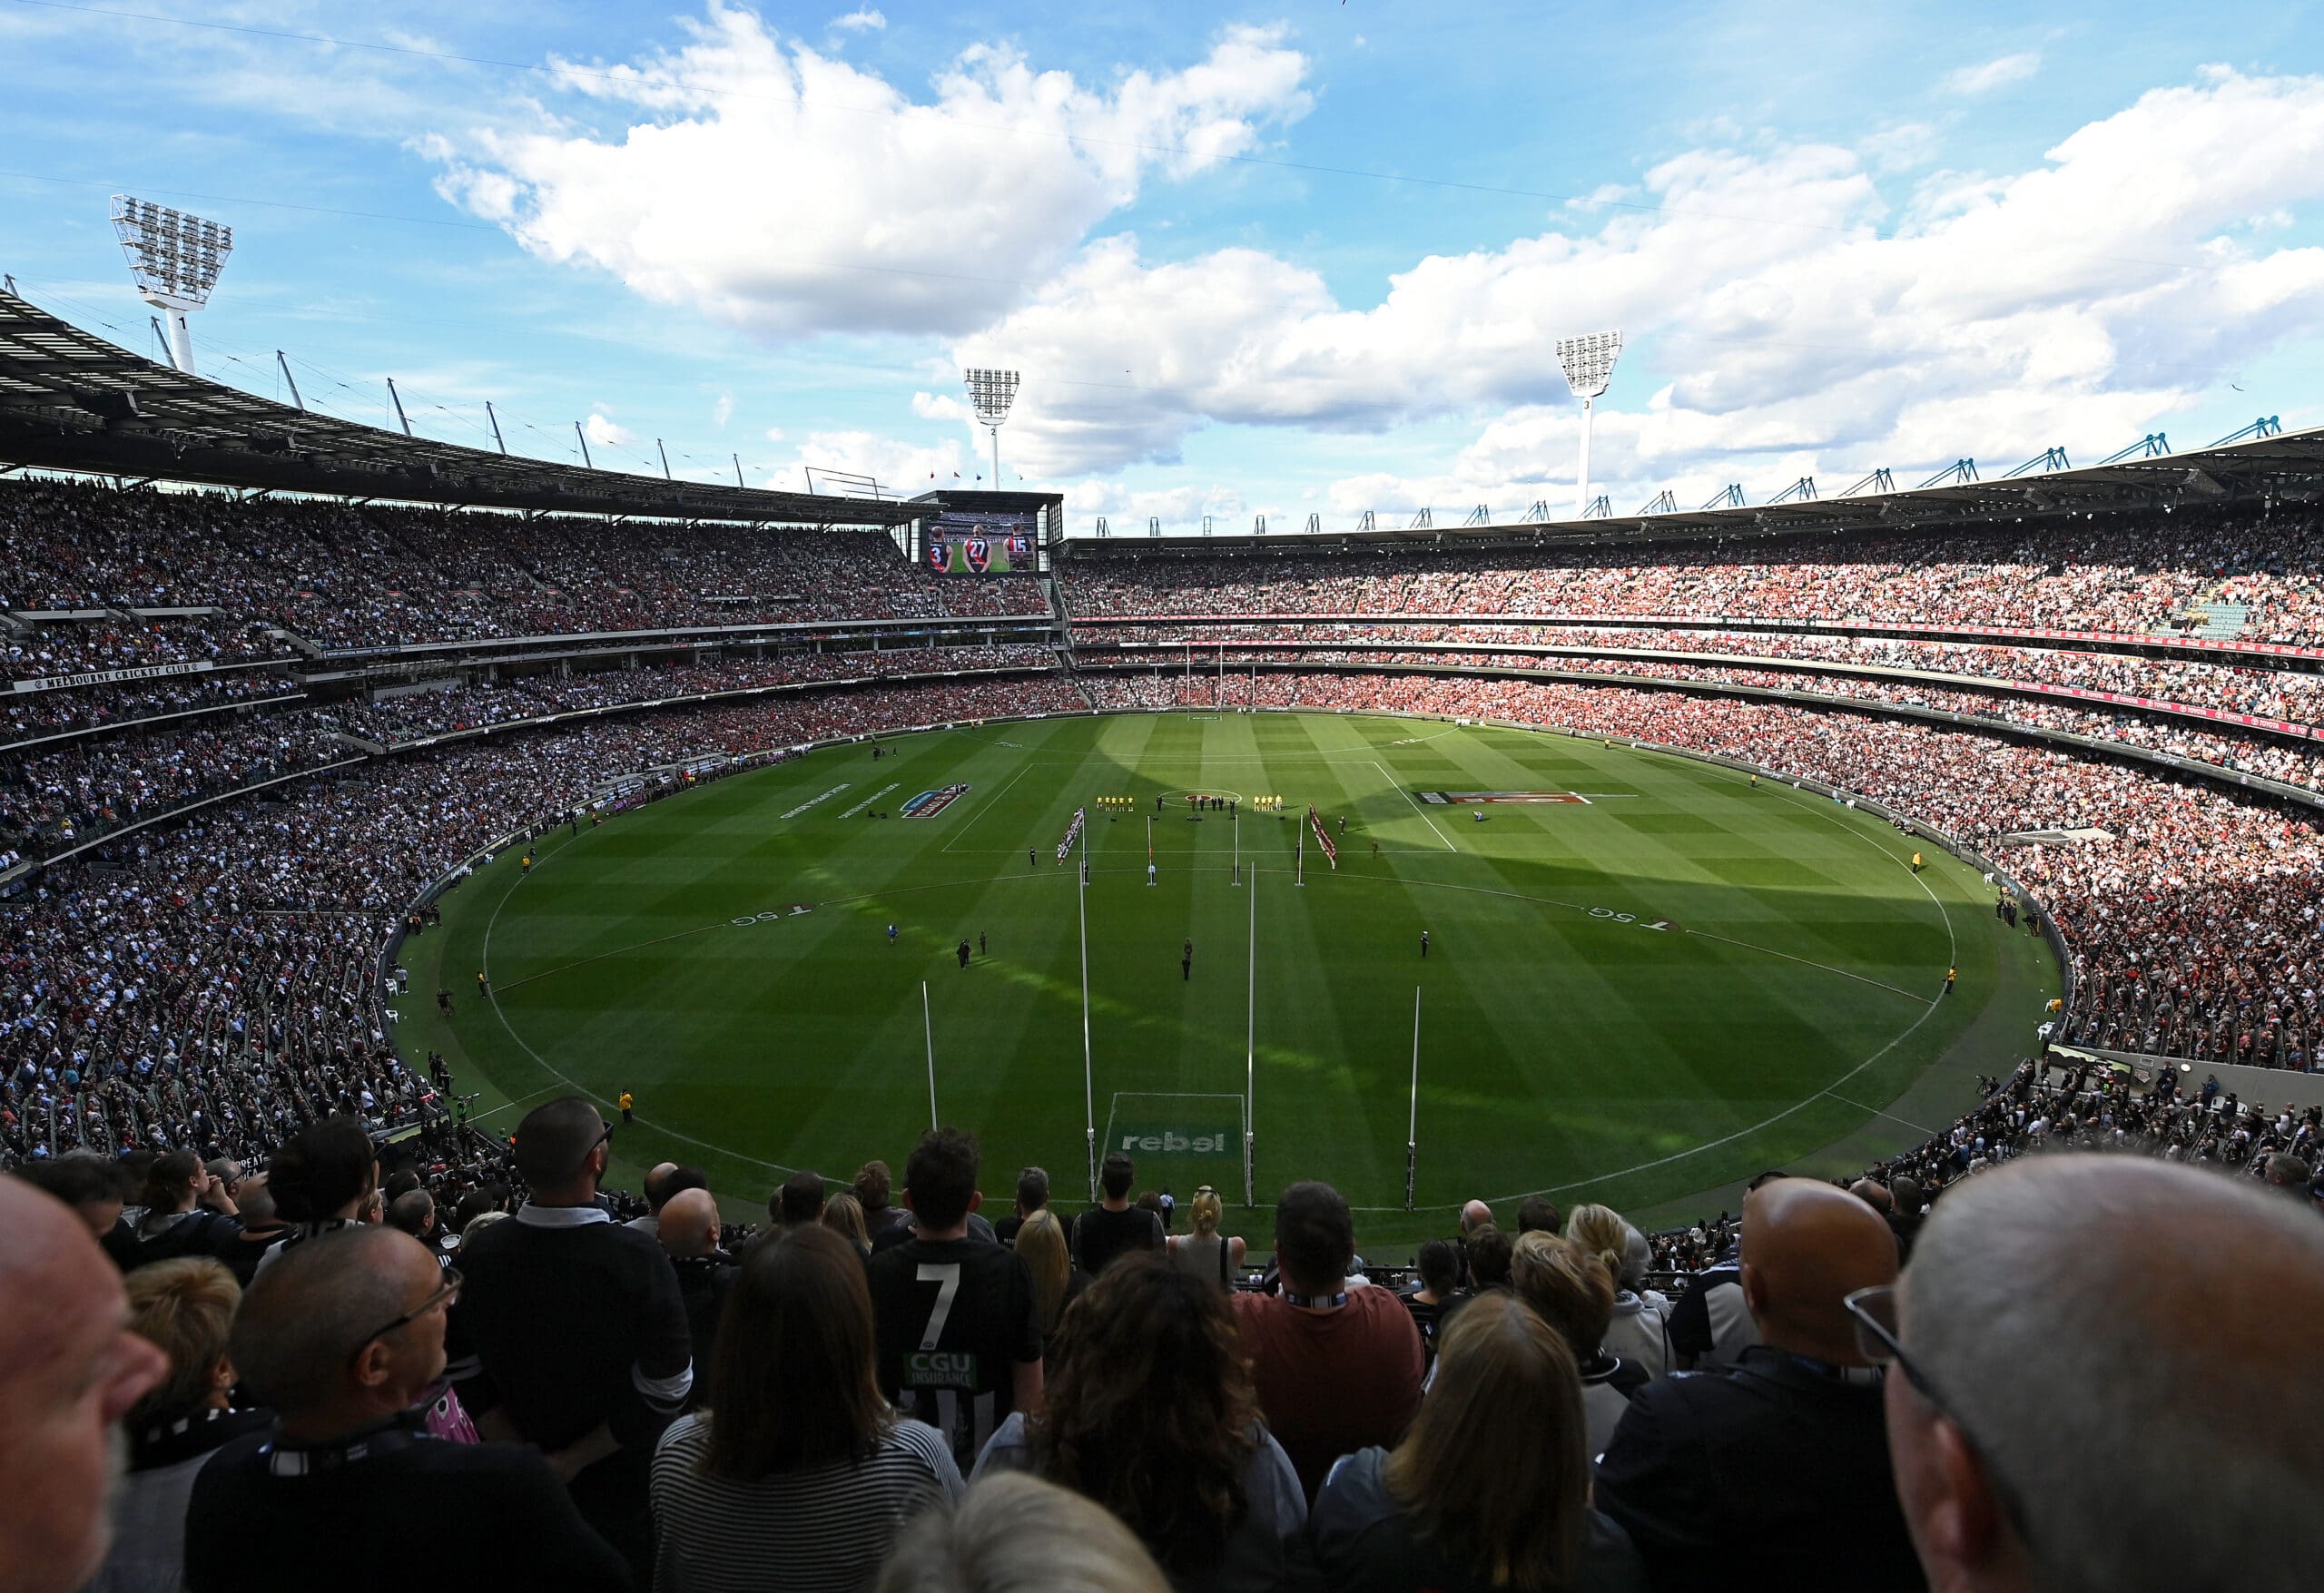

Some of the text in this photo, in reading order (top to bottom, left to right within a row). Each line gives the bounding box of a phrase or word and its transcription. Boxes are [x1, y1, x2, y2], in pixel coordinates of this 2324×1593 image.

[178, 316, 186, 329] 1
[1583, 400, 1590, 409] 3
[990, 428, 996, 436] 2
[970, 541, 986, 557] 27
[1013, 539, 1027, 552] 15
[931, 546, 941, 563] 3
[47, 673, 111, 688] MELBOURNE
[115, 667, 161, 680] CRICKET
[165, 664, 191, 674] CLUB
[2087, 691, 2104, 699] TOYOTA
[2119, 696, 2138, 704] TOYOTA
[2153, 702, 2172, 710] TOYOTA
[2186, 707, 2207, 716] TOYOTA
[2224, 713, 2243, 723] TOYOTA
[2260, 720, 2280, 730] TOYOTA
[2297, 728, 2319, 738] TOYTA
[731, 911, 779, 926] 5G
[1588, 908, 1637, 923] 5G
[1122, 1131, 1224, 1152] rebel
[915, 1263, 960, 1351] 7
[910, 1352, 970, 1372] CGU
[911, 1372, 973, 1386] INSURANCE
